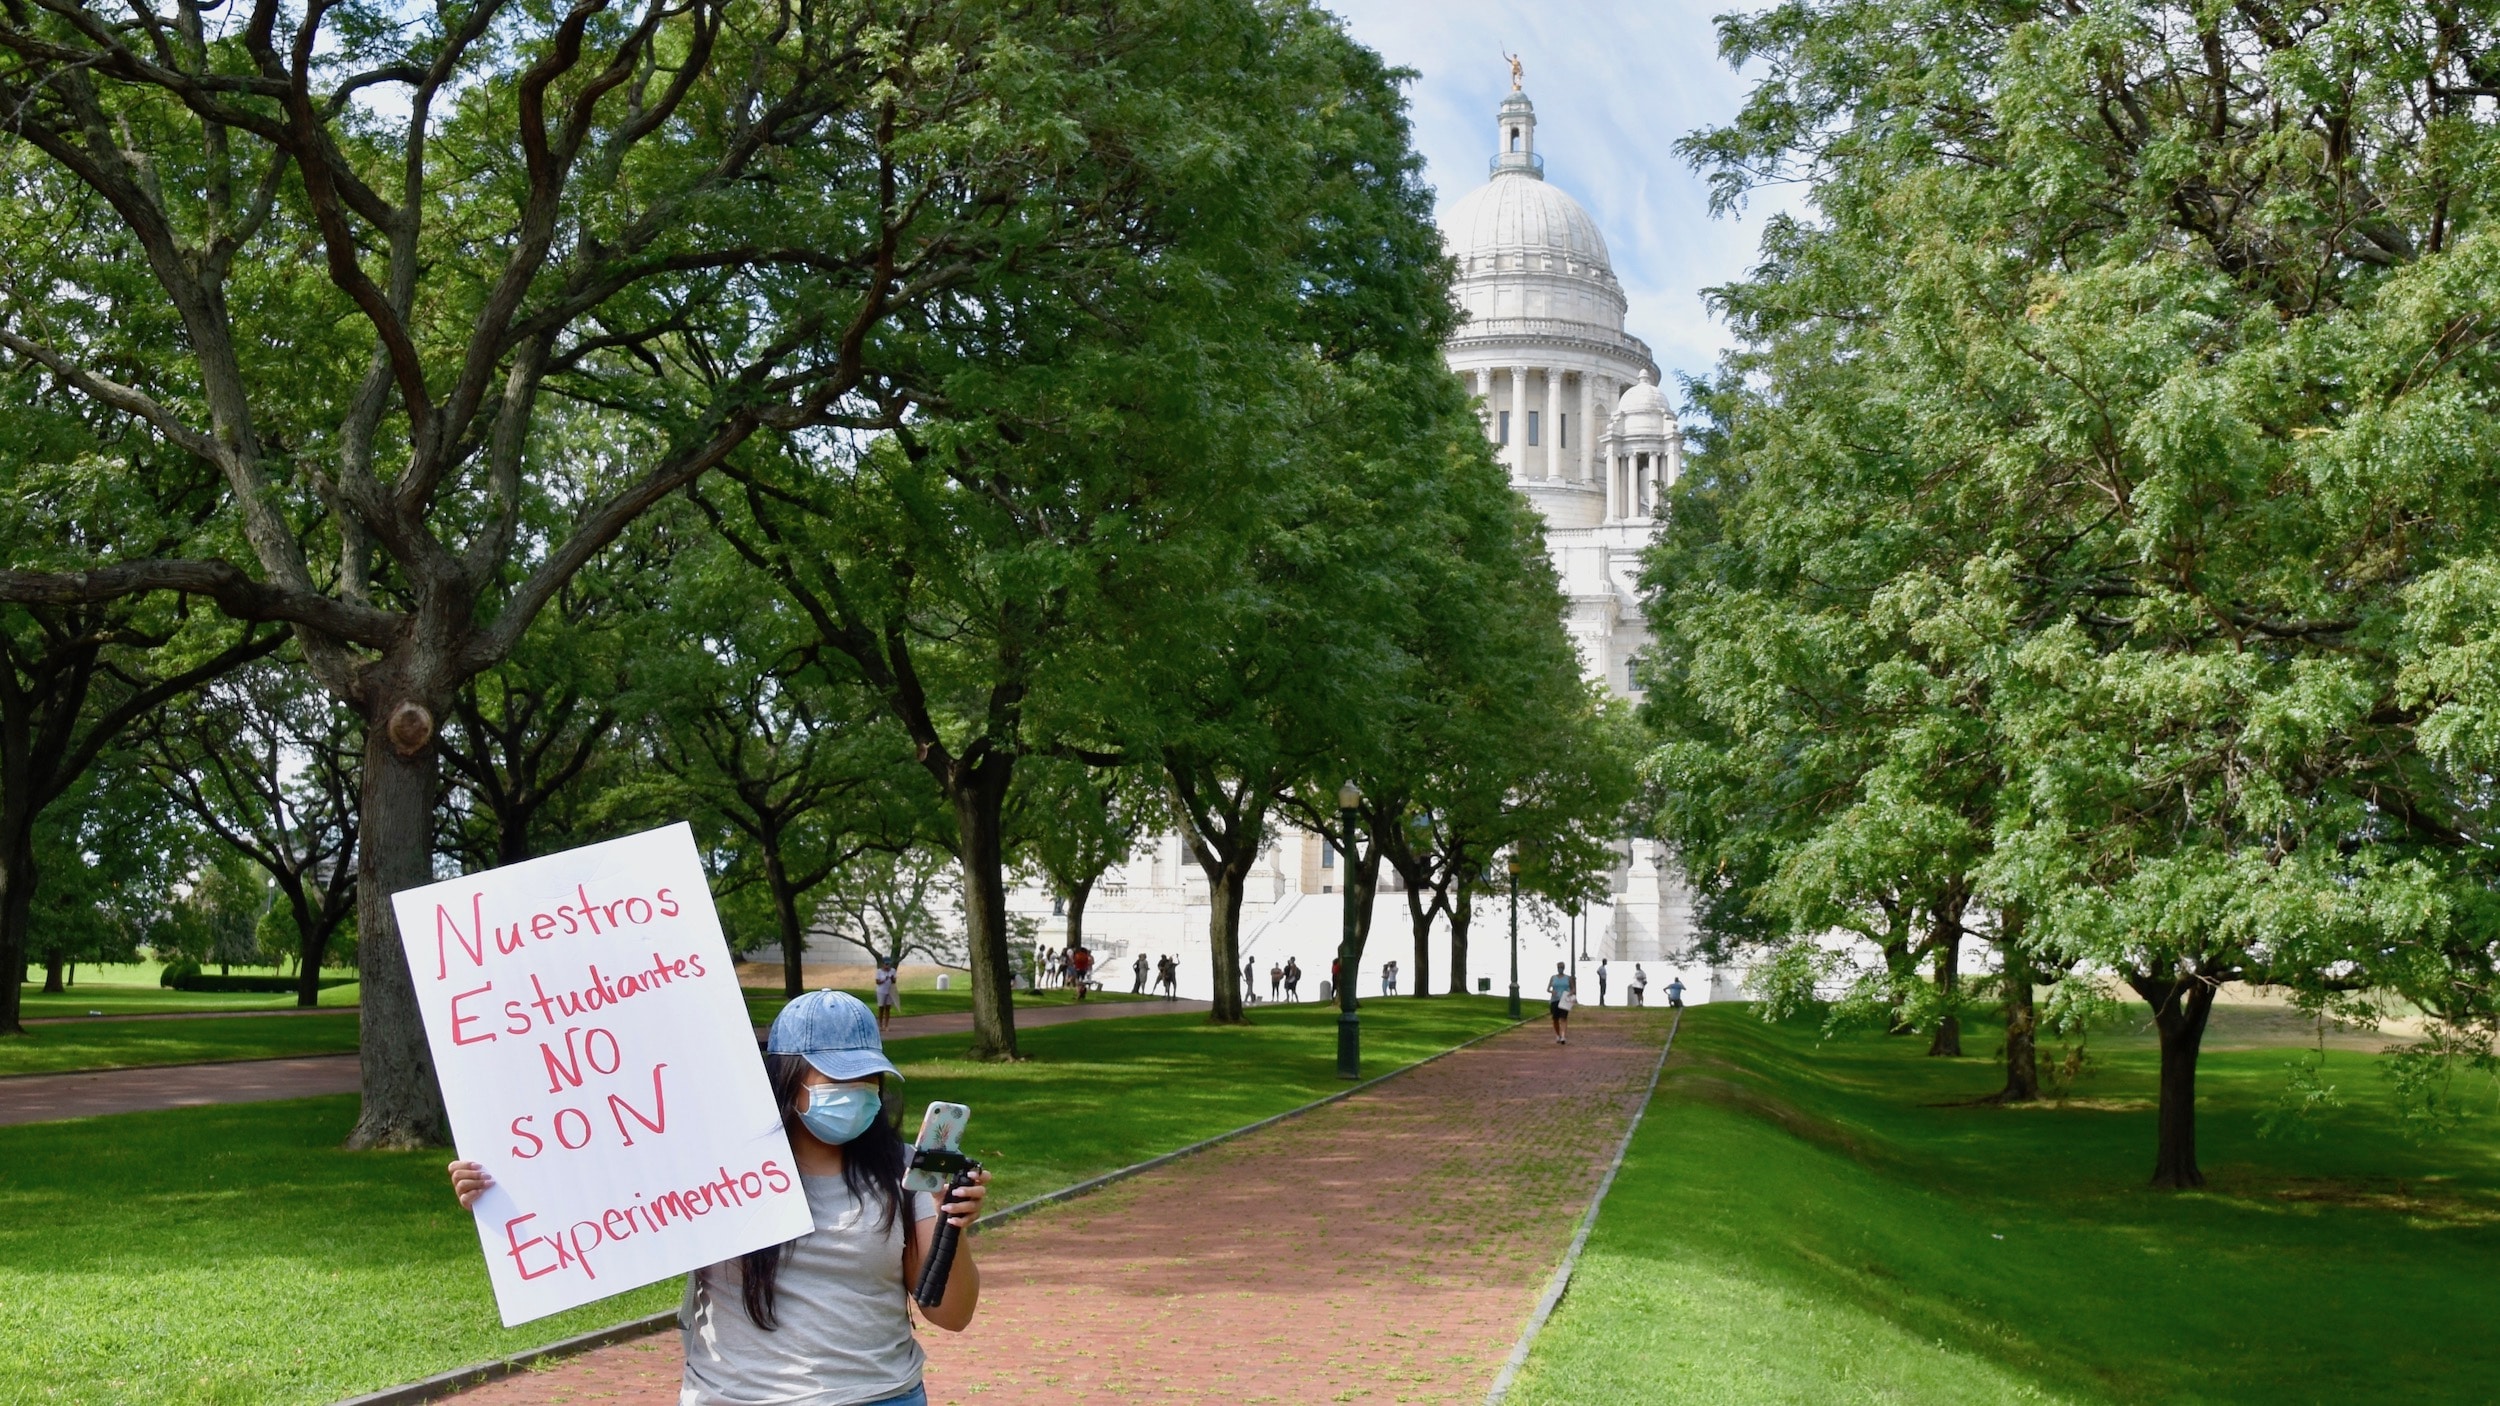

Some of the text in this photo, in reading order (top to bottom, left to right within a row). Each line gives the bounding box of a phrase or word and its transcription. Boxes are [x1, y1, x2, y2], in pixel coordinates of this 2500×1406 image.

[436, 884, 680, 981] Nuestros
[450, 952, 706, 1046] Estudiantes
[539, 1026, 621, 1094] NO
[511, 1063, 667, 1159] SON
[505, 1160, 791, 1280] Experimentos
